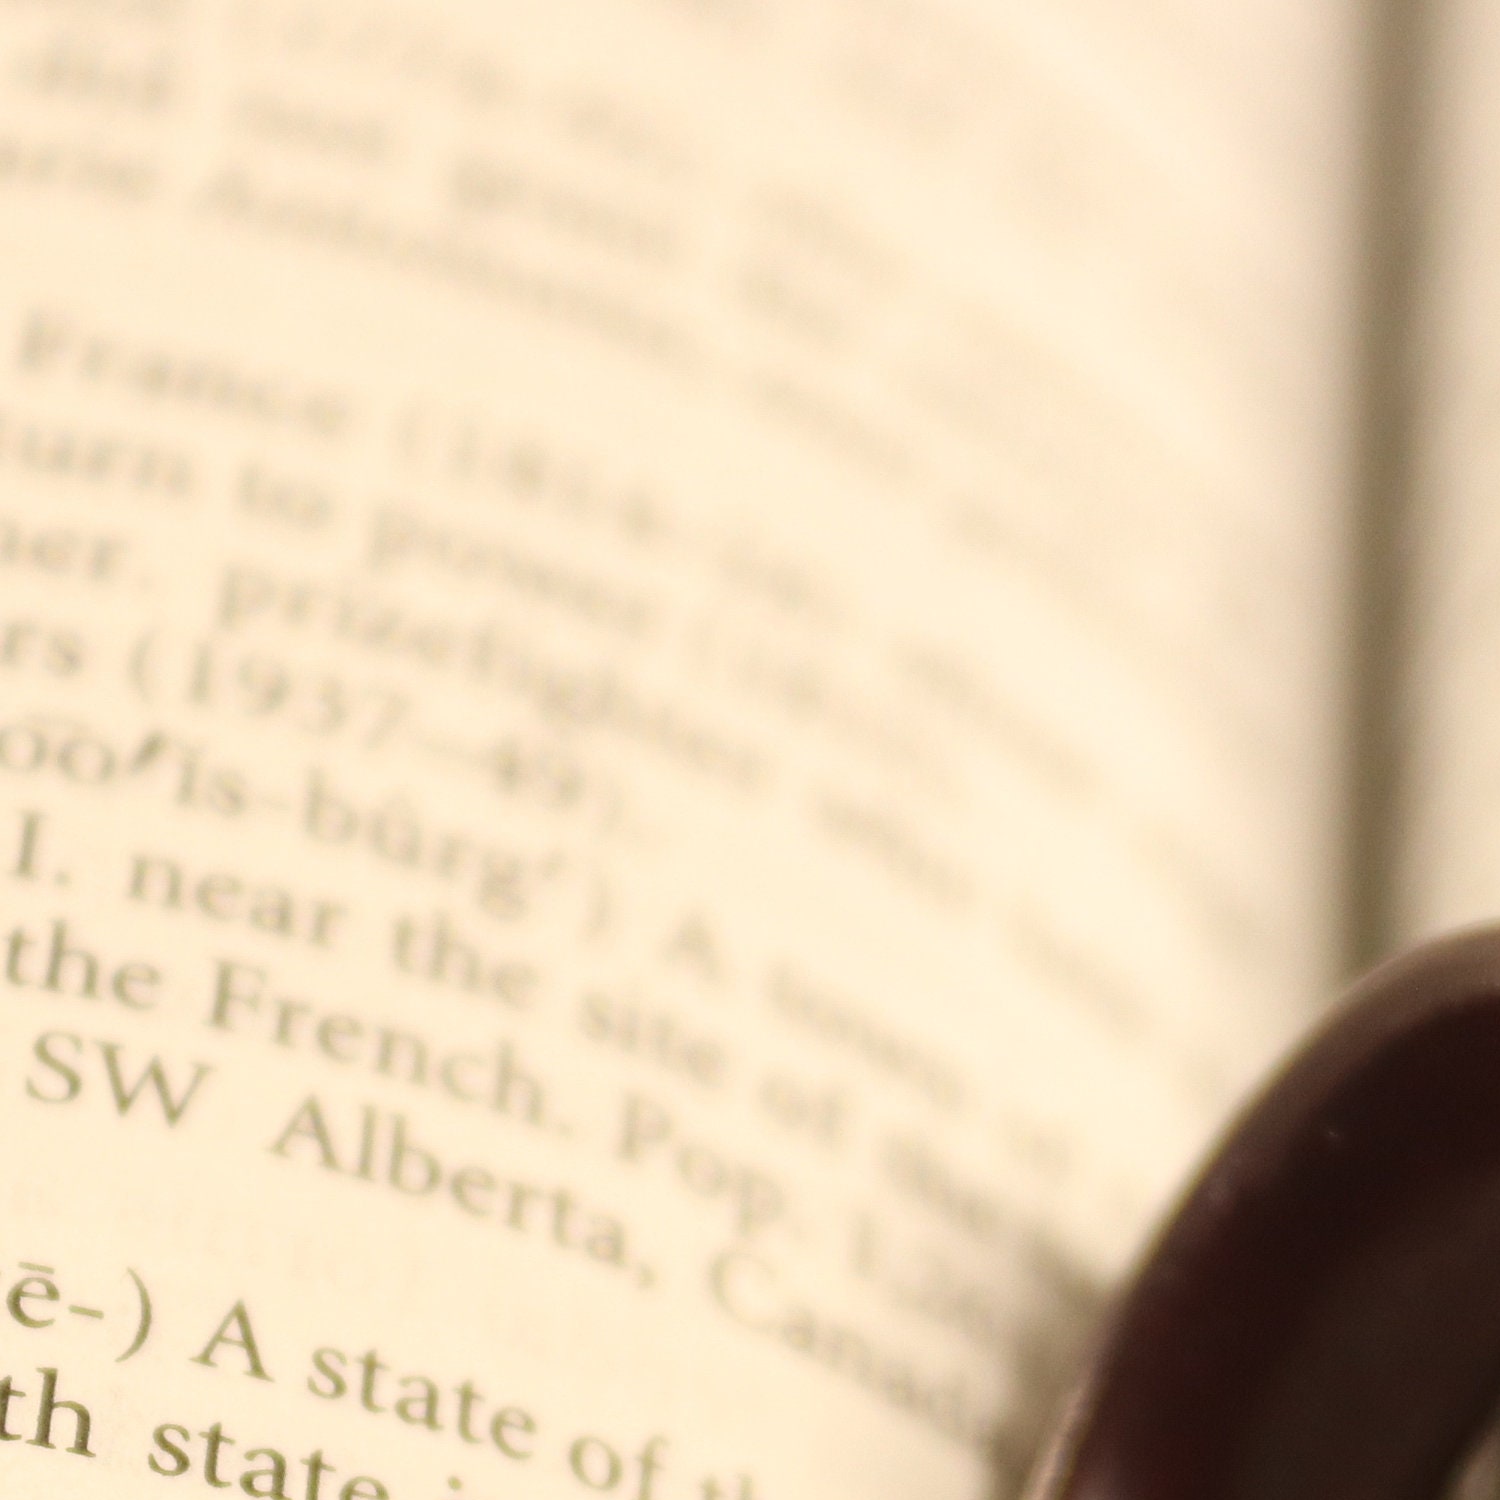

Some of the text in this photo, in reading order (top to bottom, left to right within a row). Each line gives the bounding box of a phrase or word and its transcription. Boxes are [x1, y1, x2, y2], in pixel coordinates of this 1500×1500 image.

[126, 849, 350, 950] near
[393, 909, 542, 1000] the
[3, 918, 163, 1013] the
[203, 957, 578, 1140] French.
[22, 1028, 659, 1290] SW Alberta,
[191, 1299, 276, 1384] A
[306, 1344, 540, 1462] state
